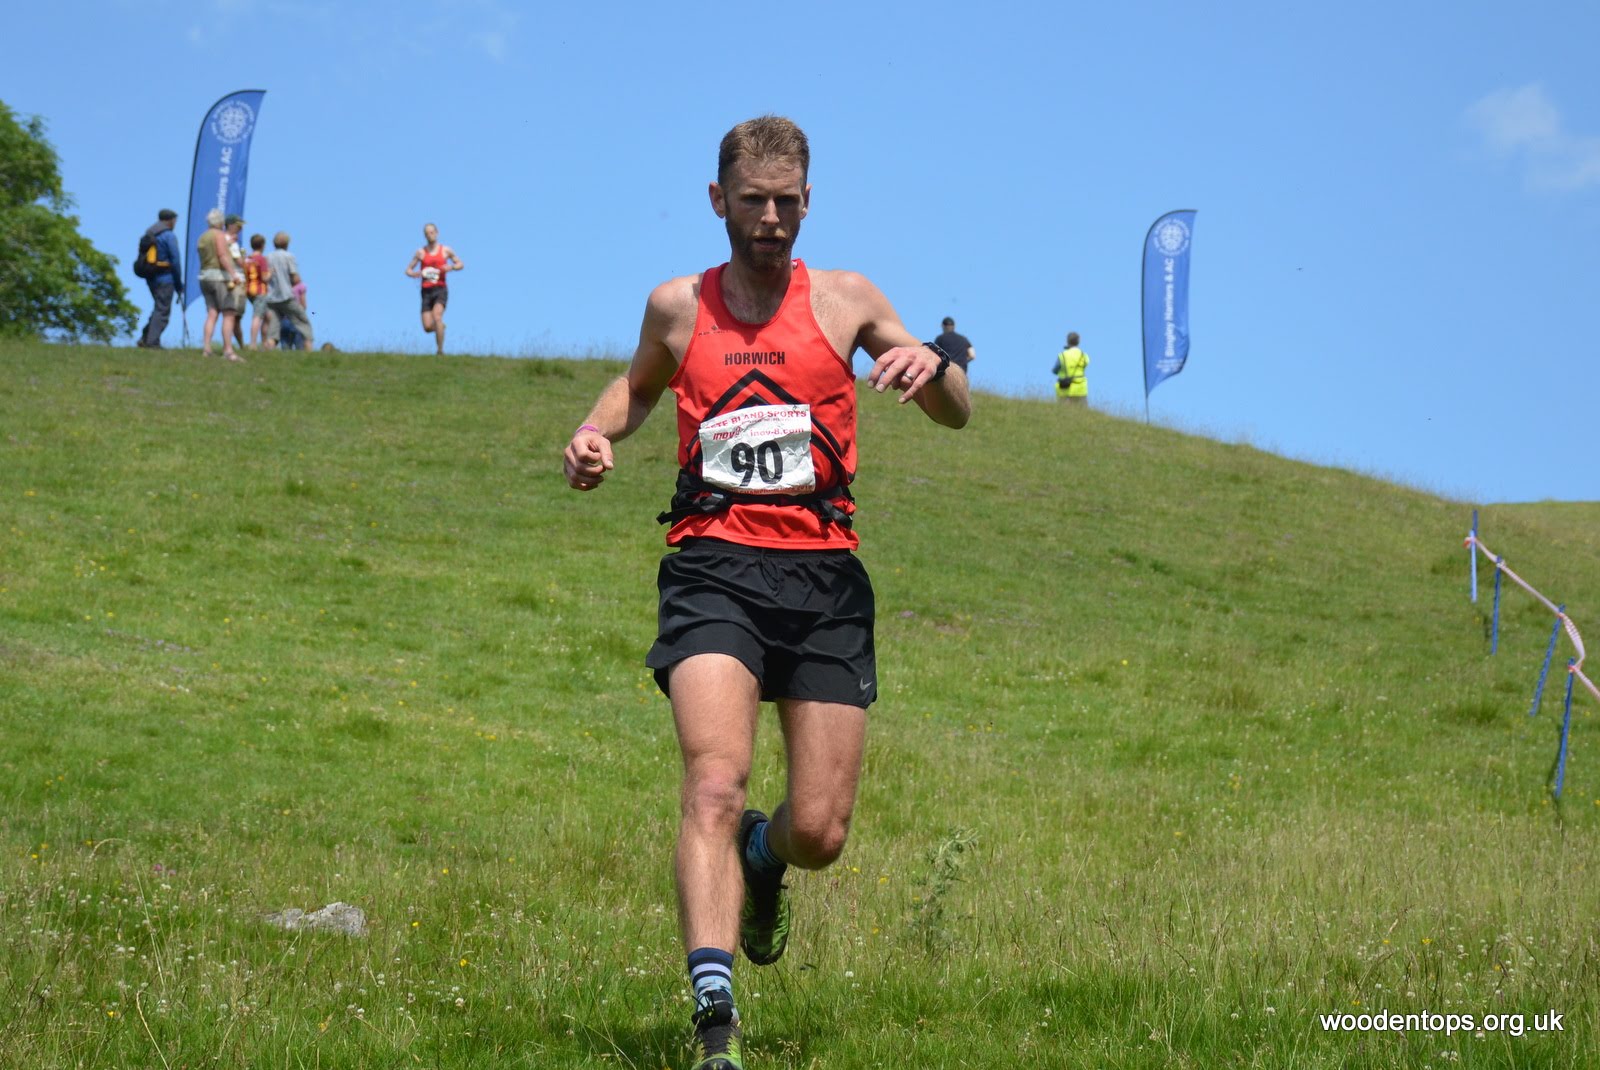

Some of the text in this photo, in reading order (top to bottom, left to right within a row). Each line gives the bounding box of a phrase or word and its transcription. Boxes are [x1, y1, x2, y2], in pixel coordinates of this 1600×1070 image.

[217, 146, 232, 212] arriers & AC
[1164, 258, 1174, 273] AC
[724, 351, 786, 366] HORWICH
[767, 410, 807, 418] SPORTS
[730, 440, 784, 487] 90
